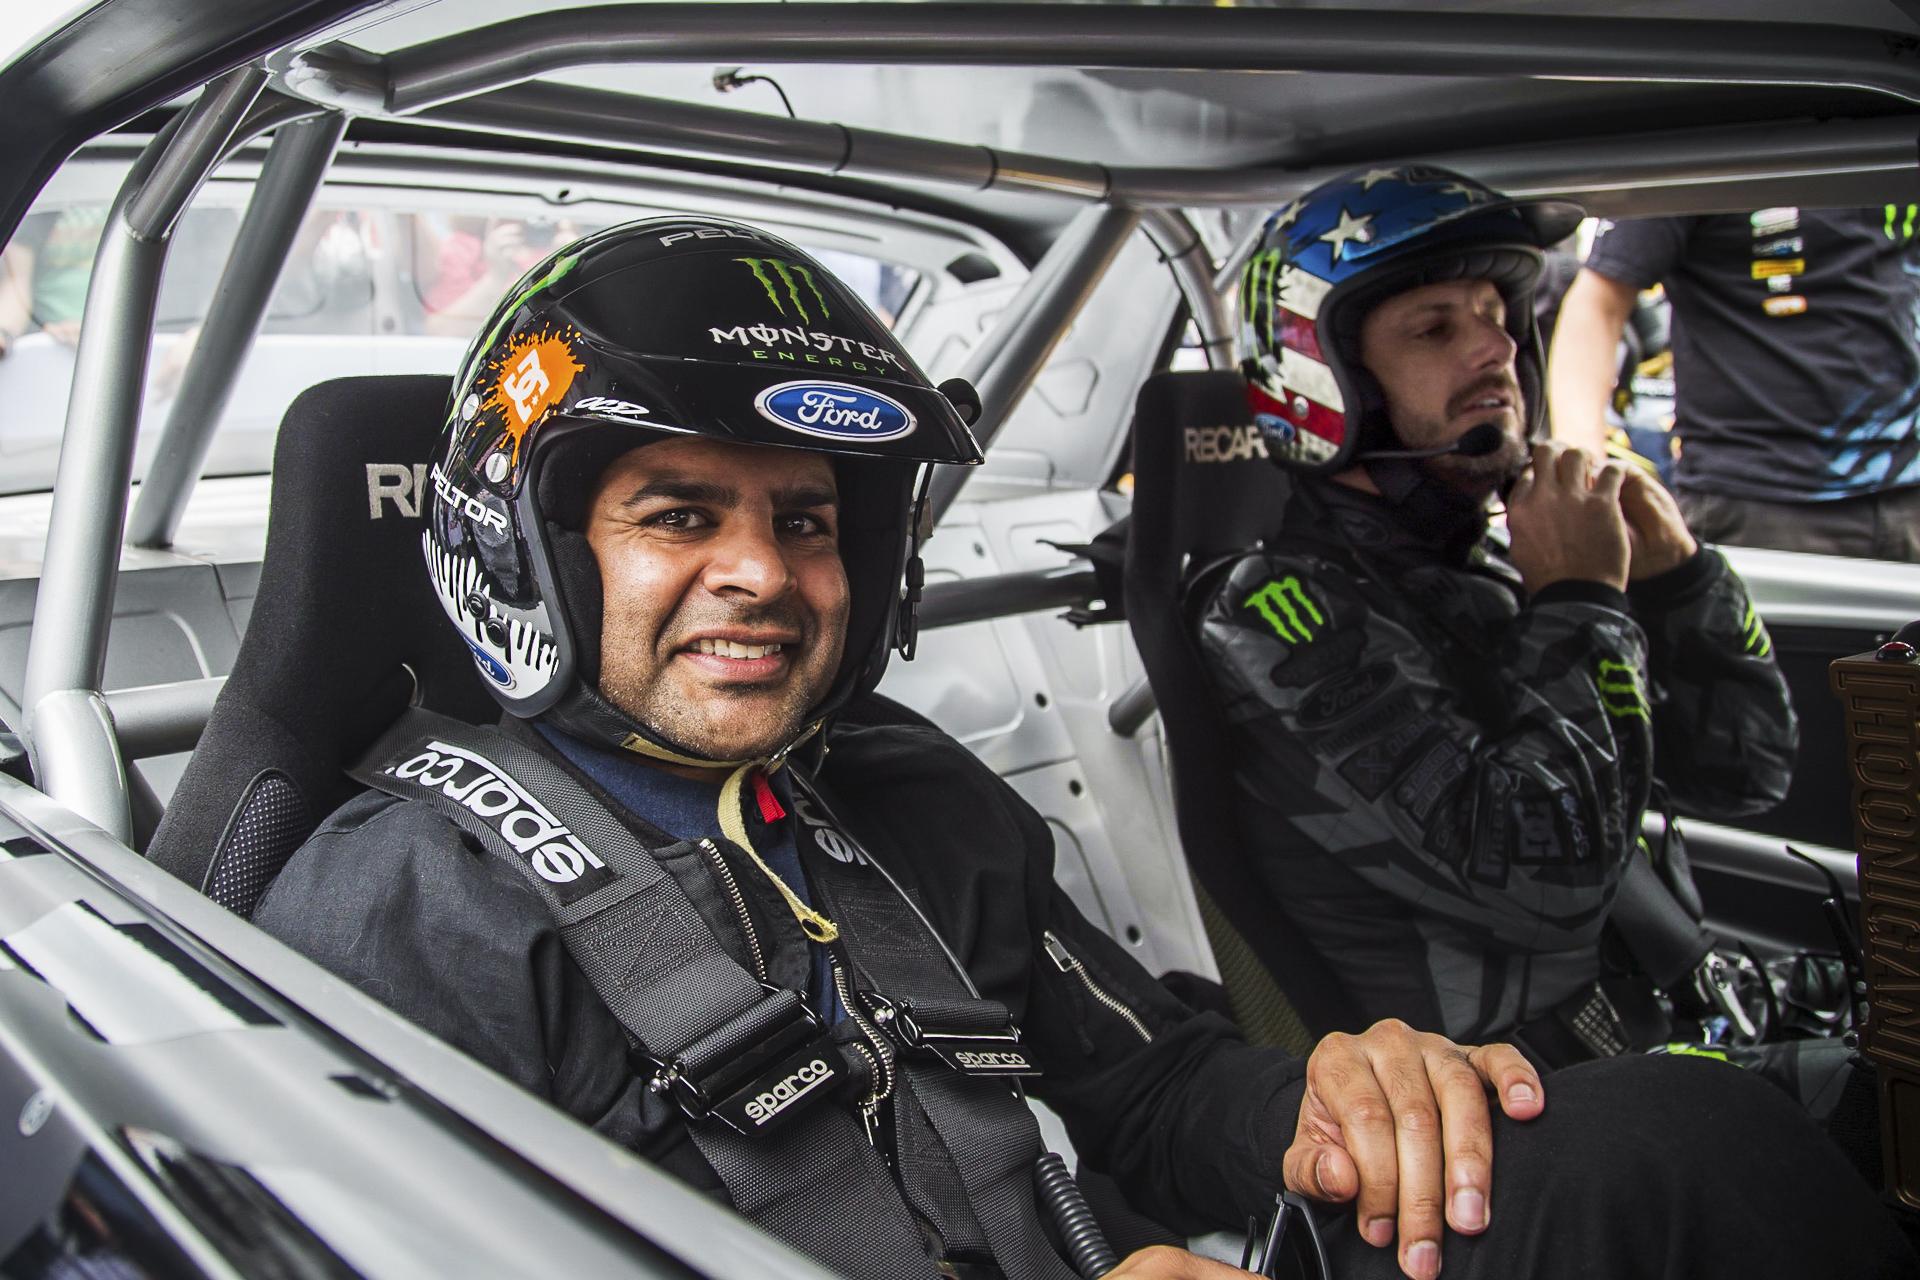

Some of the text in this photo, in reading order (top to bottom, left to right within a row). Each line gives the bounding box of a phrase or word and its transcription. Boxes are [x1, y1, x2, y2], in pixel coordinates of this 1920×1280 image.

[752, 350, 886, 375] ENERGY
[796, 390, 882, 430] Ford
[430, 462, 508, 535] PELTOR
[395, 745, 588, 882] sparco
[955, 1050, 1026, 1067] sparco
[744, 1058, 830, 1122] sparco
